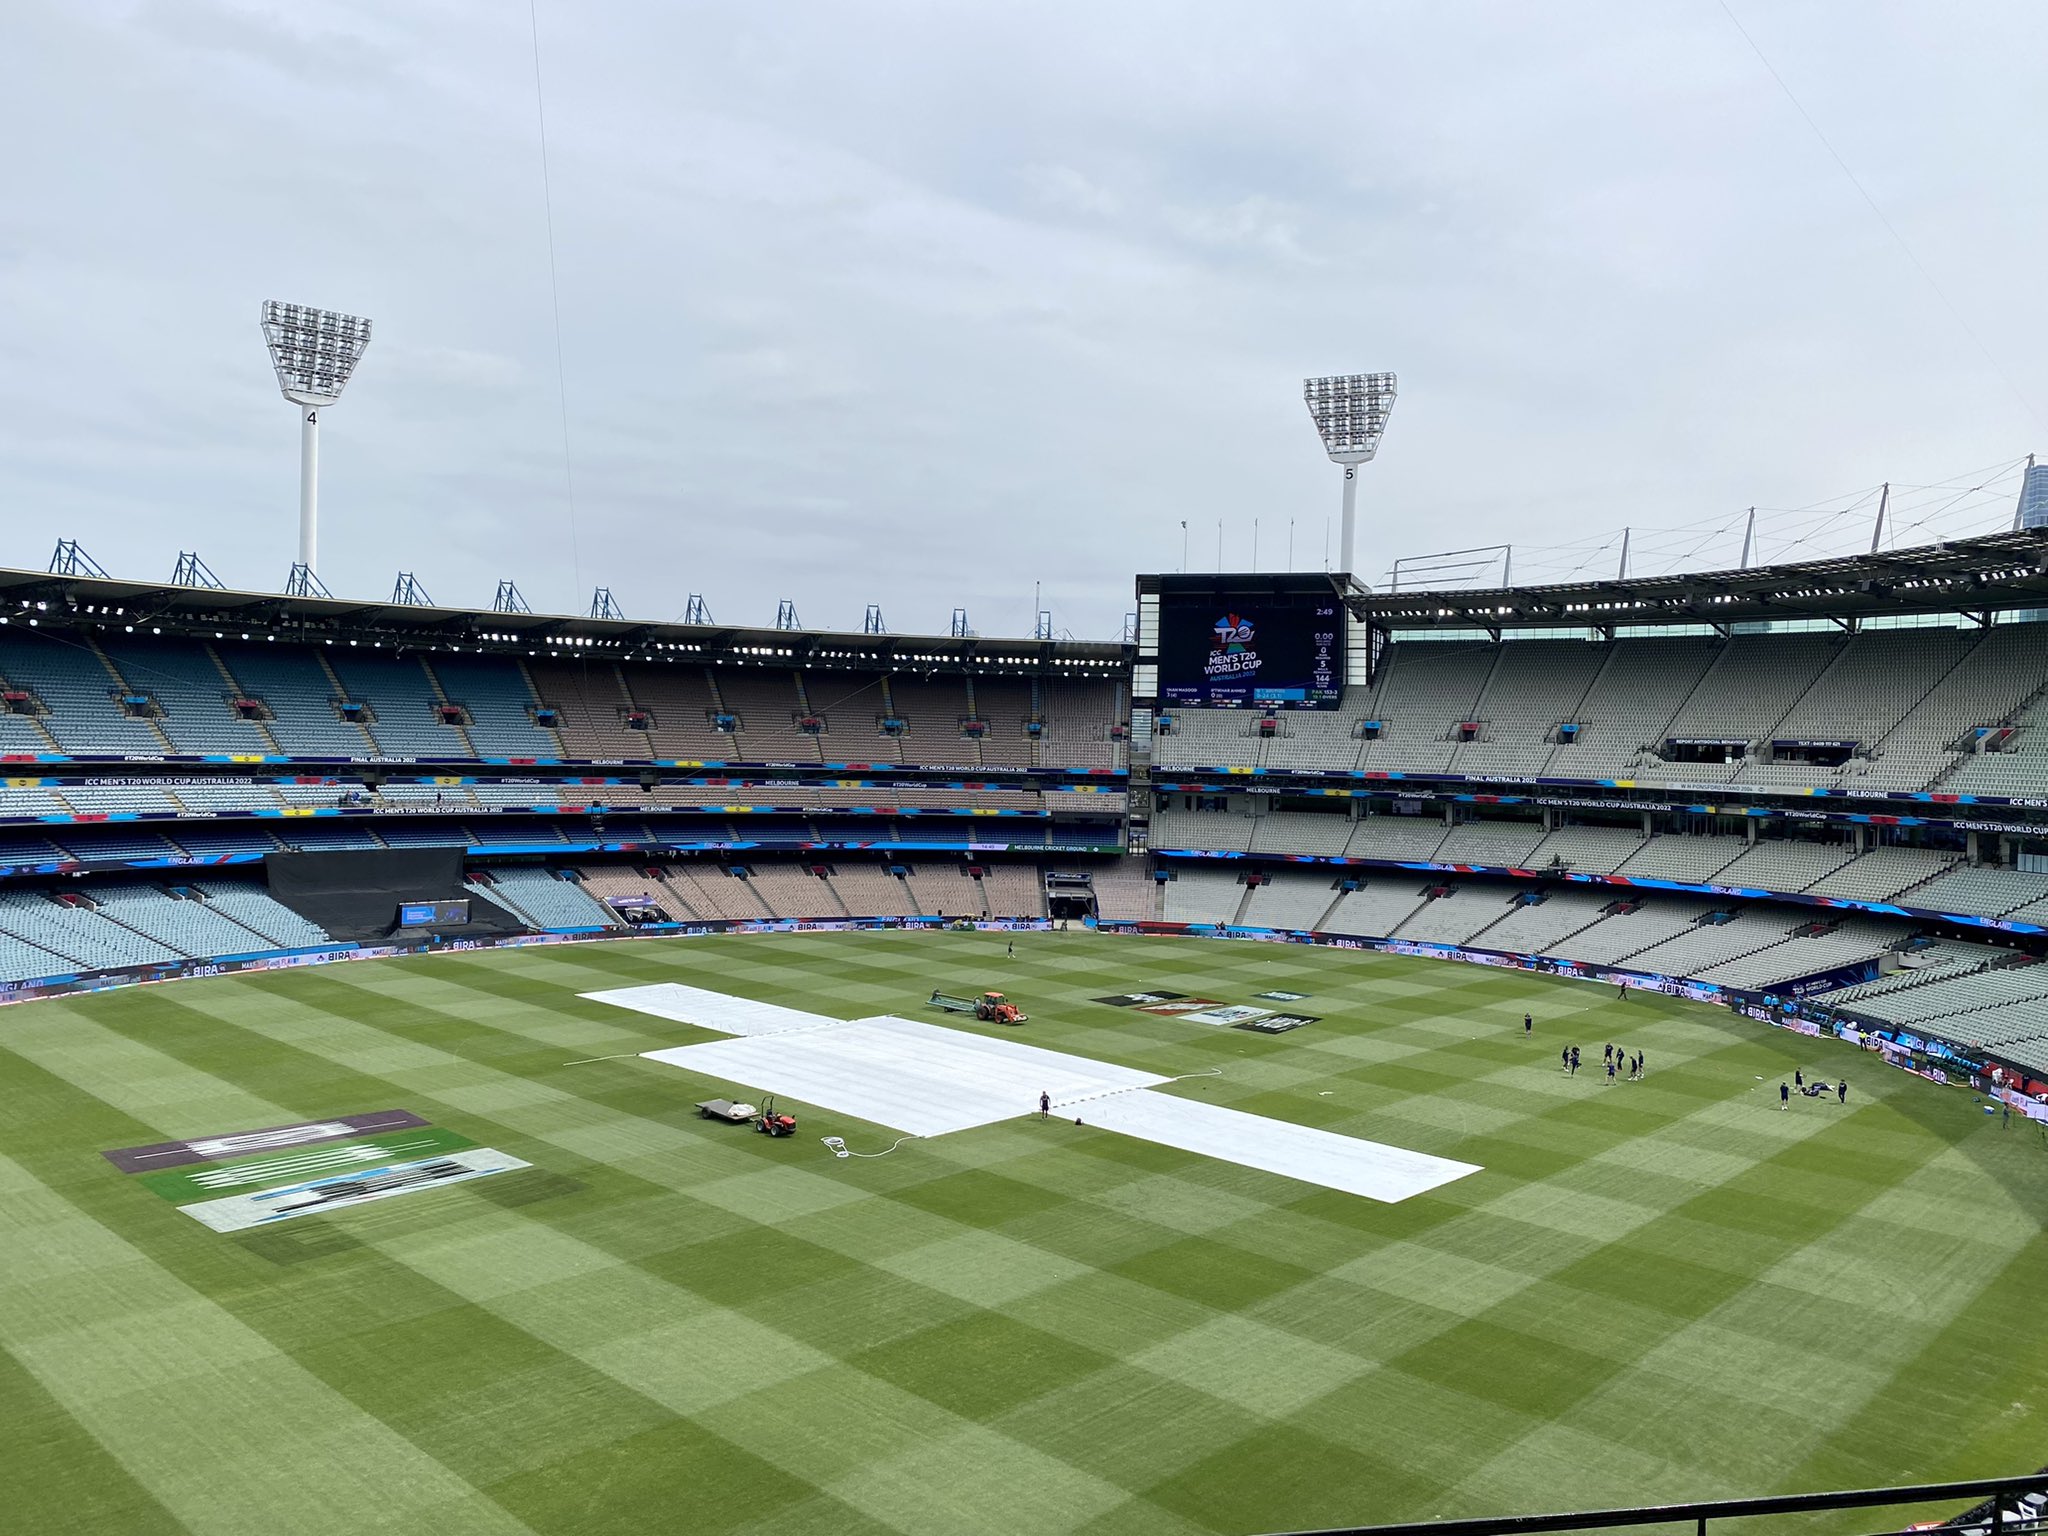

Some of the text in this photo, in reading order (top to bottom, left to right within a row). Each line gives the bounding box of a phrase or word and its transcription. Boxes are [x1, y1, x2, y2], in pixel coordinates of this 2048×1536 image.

[307, 411, 317, 425] 4
[1345, 468, 1354, 480] 5
[1316, 608, 1333, 616] 2:49
[1314, 632, 1333, 640] 0.00
[1209, 651, 1256, 665] MEN'S T20
[1204, 660, 1262, 674] WORLD CUP
[1320, 660, 1326, 668] 5
[1210, 673, 1241, 681] AUSTRALIA
[1246, 786, 1280, 794] MELBOURNE
[1846, 790, 1888, 798] MELBOURNE
[2025, 799, 2048, 807] MEN'S
[1785, 811, 1827, 819] #T20WorldCup
[1953, 821, 1966, 829] ICC
[1966, 822, 1989, 831] MEN'S
[2002, 825, 2031, 833] WORLD
[2033, 827, 2048, 835] CUP
[167, 856, 204, 865] ENGLAND
[1710, 884, 1742, 896] ENGLAND
[798, 923, 817, 931] BIRA
[905, 922, 925, 930] BIRA
[1980, 917, 2012, 930] ENGLAND
[686, 927, 707, 935] BIRA
[1118, 926, 1138, 934] BIRA
[1226, 931, 1246, 939] BIRA
[572, 933, 593, 941] BIRA
[452, 939, 475, 950] BIRA
[1336, 939, 1356, 949] BIRA
[328, 951, 350, 962] BIRA
[1447, 950, 1467, 961] BIRA
[193, 965, 219, 977] BIRA
[1557, 966, 1580, 977] BIRA
[0, 979, 44, 993] NGLAND
[1666, 984, 1686, 996] BIRA
[1747, 1007, 1766, 1020] BIRA
